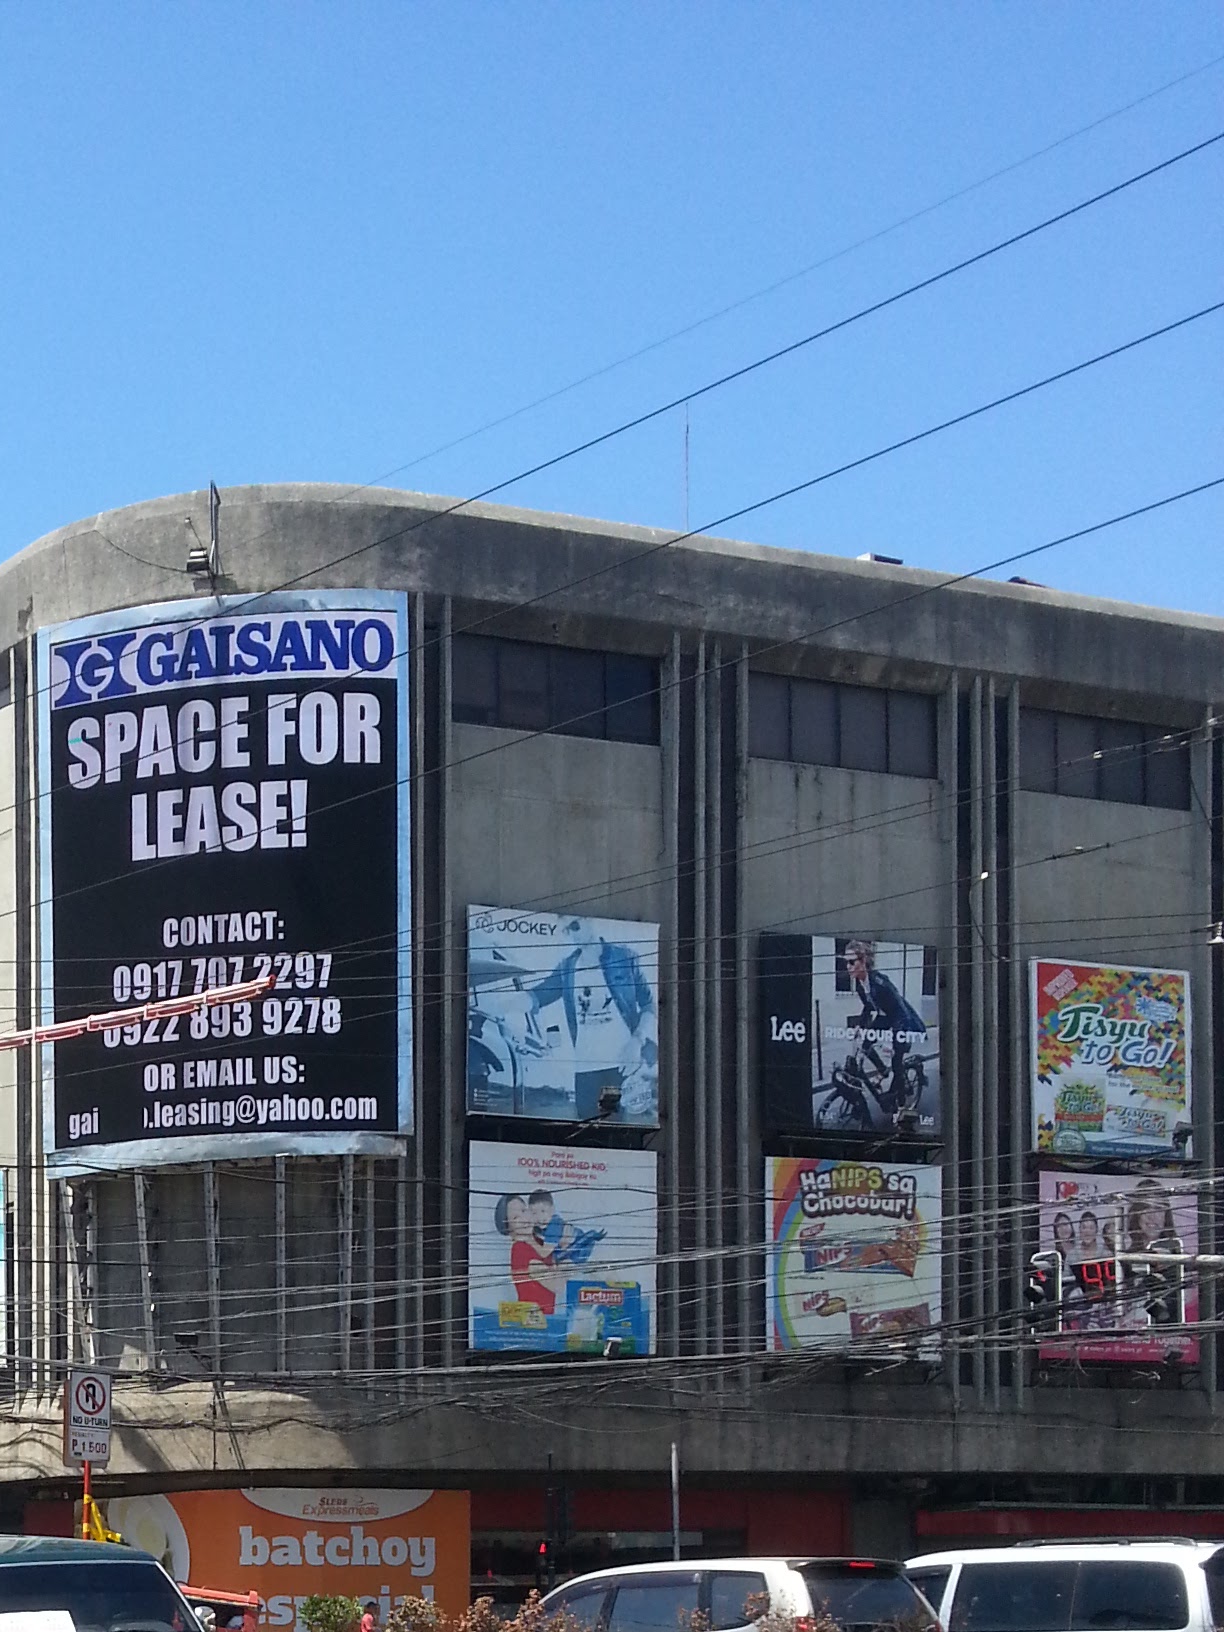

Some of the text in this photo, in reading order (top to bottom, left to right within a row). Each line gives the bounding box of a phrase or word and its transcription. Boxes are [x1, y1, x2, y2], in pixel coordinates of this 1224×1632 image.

[136, 618, 394, 687] GAISANO
[67, 692, 381, 790] SPACE FOR
[131, 779, 308, 861] LEASE!
[163, 911, 285, 948] CONTACT:
[496, 919, 557, 936] JOCKEY
[113, 953, 333, 1003] 0917 707 2297
[103, 997, 341, 1049] 0922 893 9278
[770, 1015, 806, 1042] Lee
[860, 1028, 893, 1042] YOUR
[896, 1030, 927, 1043] CITY
[1059, 1005, 1148, 1043] Tisyu
[1083, 1040, 1175, 1066] to Go!
[144, 1056, 305, 1092] OR EMAIL US:
[69, 1108, 99, 1140] gai
[542, 1160, 590, 1170] NOURISHED
[800, 1168, 882, 1191] HaNIPS
[803, 1190, 913, 1214] Chocobar!
[580, 1290, 623, 1303] Lactum
[72, 1415, 109, 1428] NO U-TURN
[239, 1525, 436, 1577] batchoy
